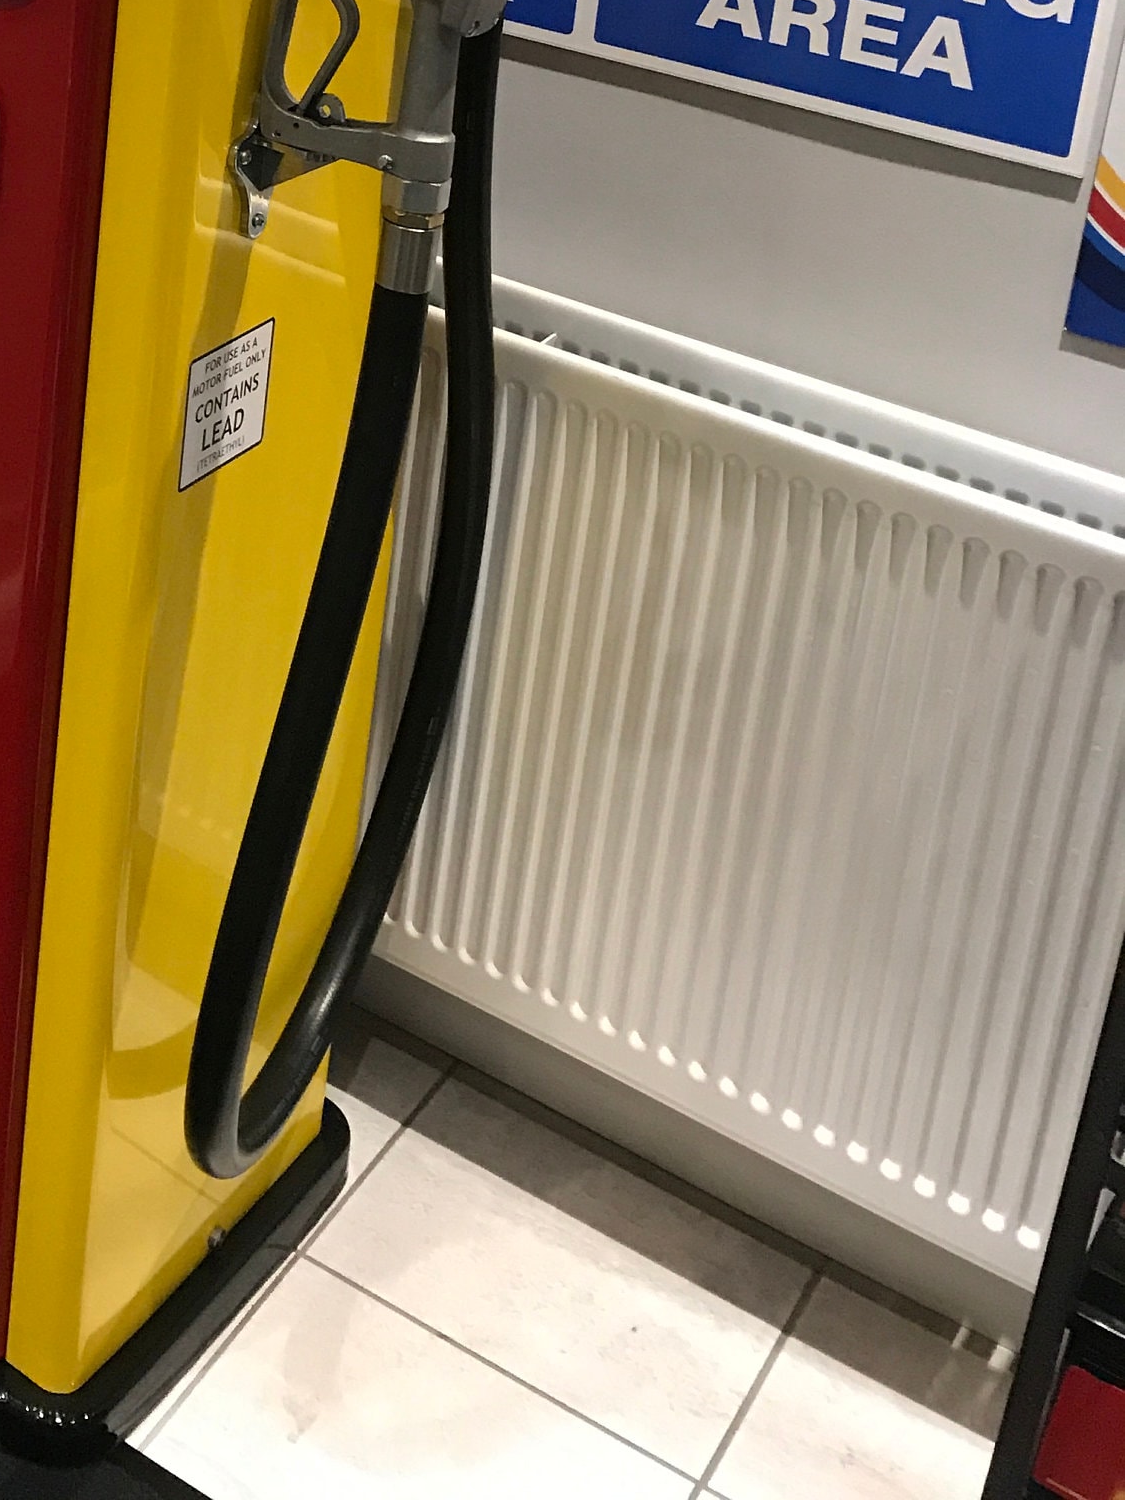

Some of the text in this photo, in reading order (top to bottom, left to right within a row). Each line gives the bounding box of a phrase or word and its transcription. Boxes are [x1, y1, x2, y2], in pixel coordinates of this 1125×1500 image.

[192, 347, 267, 399] MOTOR FUEL ONLY
[205, 336, 258, 375] FOR USE AS A
[195, 372, 260, 424] CONTAINS
[201, 408, 245, 452] LEAD
